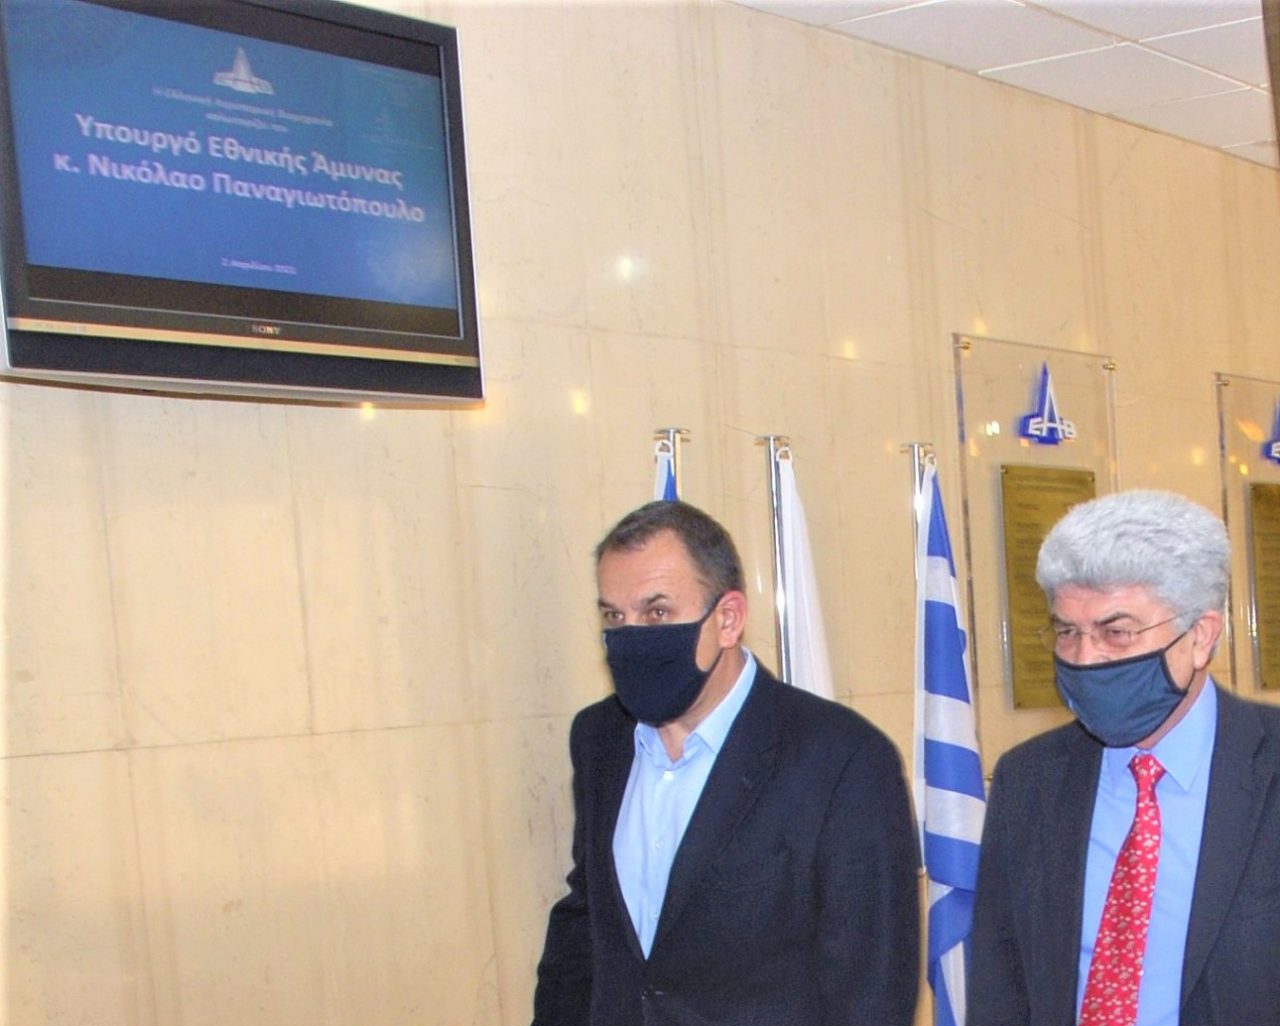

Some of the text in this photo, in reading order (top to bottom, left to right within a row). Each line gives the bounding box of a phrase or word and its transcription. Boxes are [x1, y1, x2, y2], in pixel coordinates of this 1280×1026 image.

[53, 153, 425, 223] κ. Νικόλαο Παναγιωτόπουλο
[75, 113, 201, 156] Υπουργό
[207, 136, 309, 176] Εθνικής
[310, 151, 404, 190] Άμυνας
